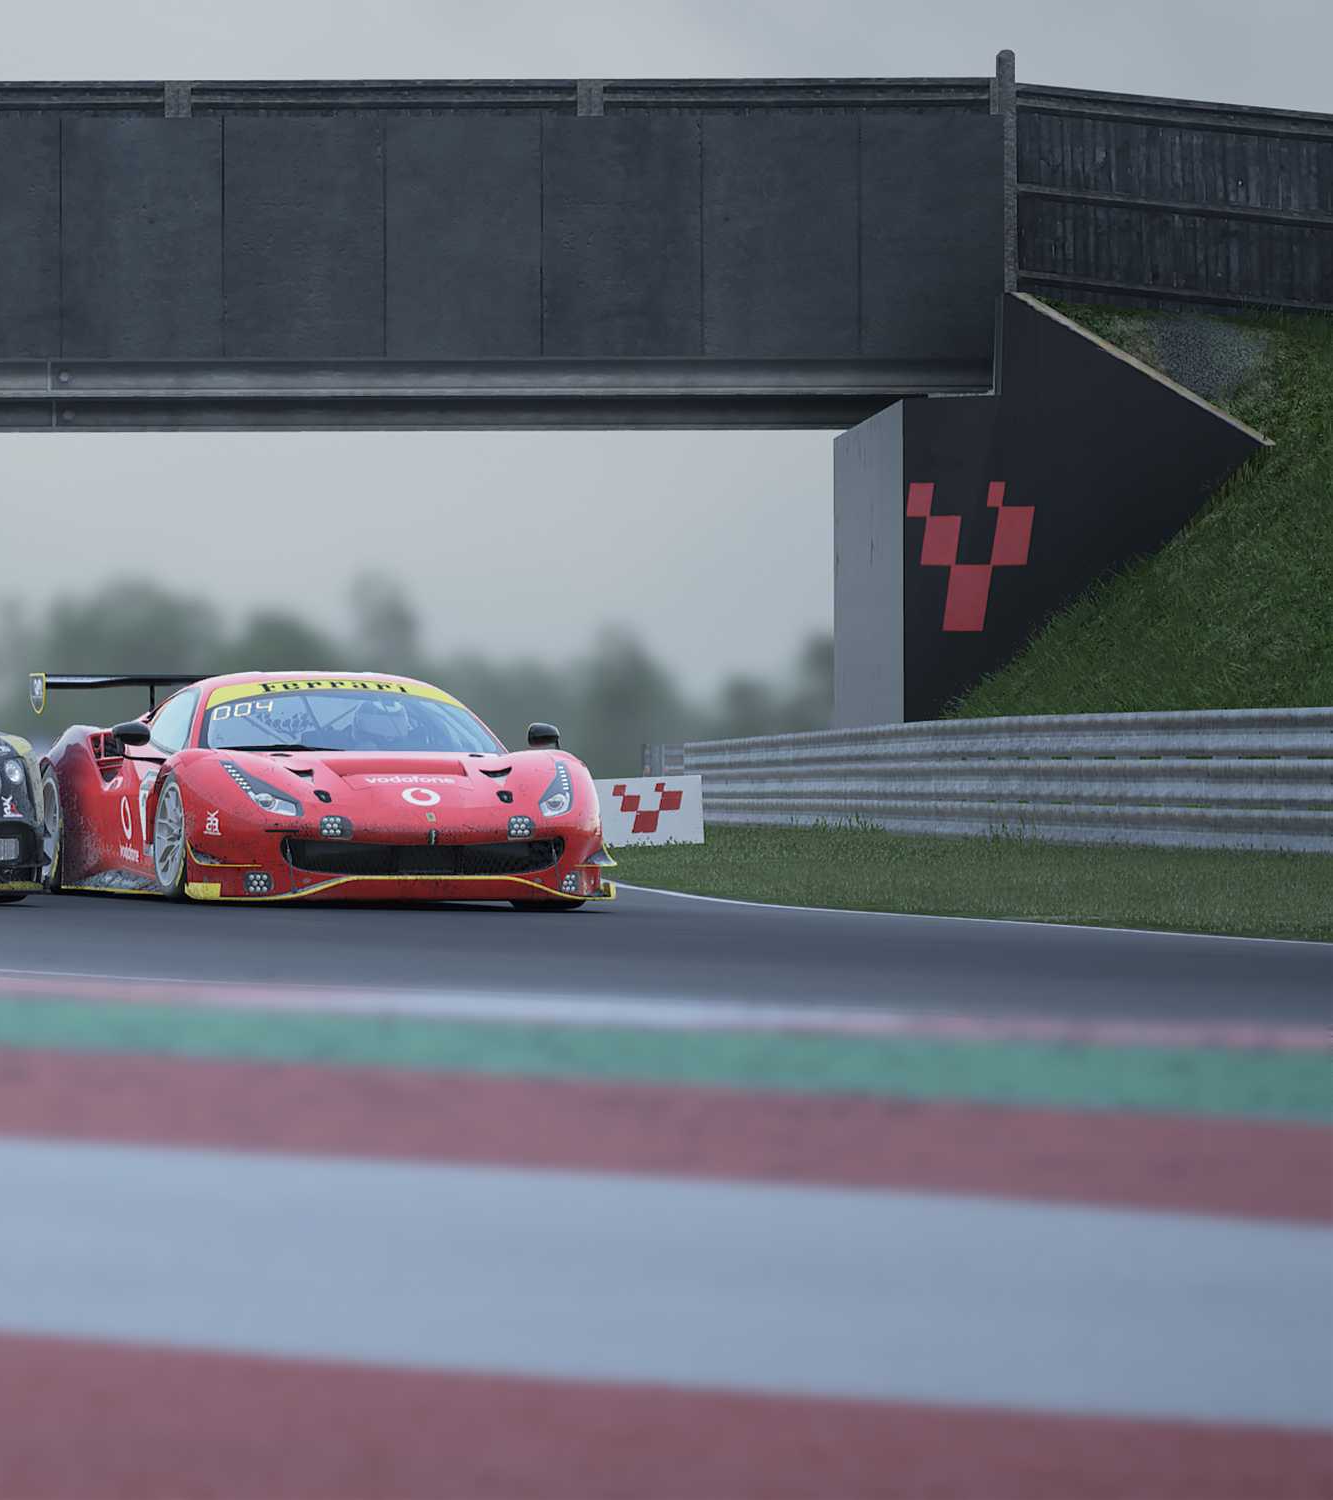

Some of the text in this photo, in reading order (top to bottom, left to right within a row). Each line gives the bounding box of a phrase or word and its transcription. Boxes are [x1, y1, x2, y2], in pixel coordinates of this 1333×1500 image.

[261, 679, 408, 693] Ferrari
[213, 700, 275, 721] 004
[363, 775, 456, 784] vodafone
